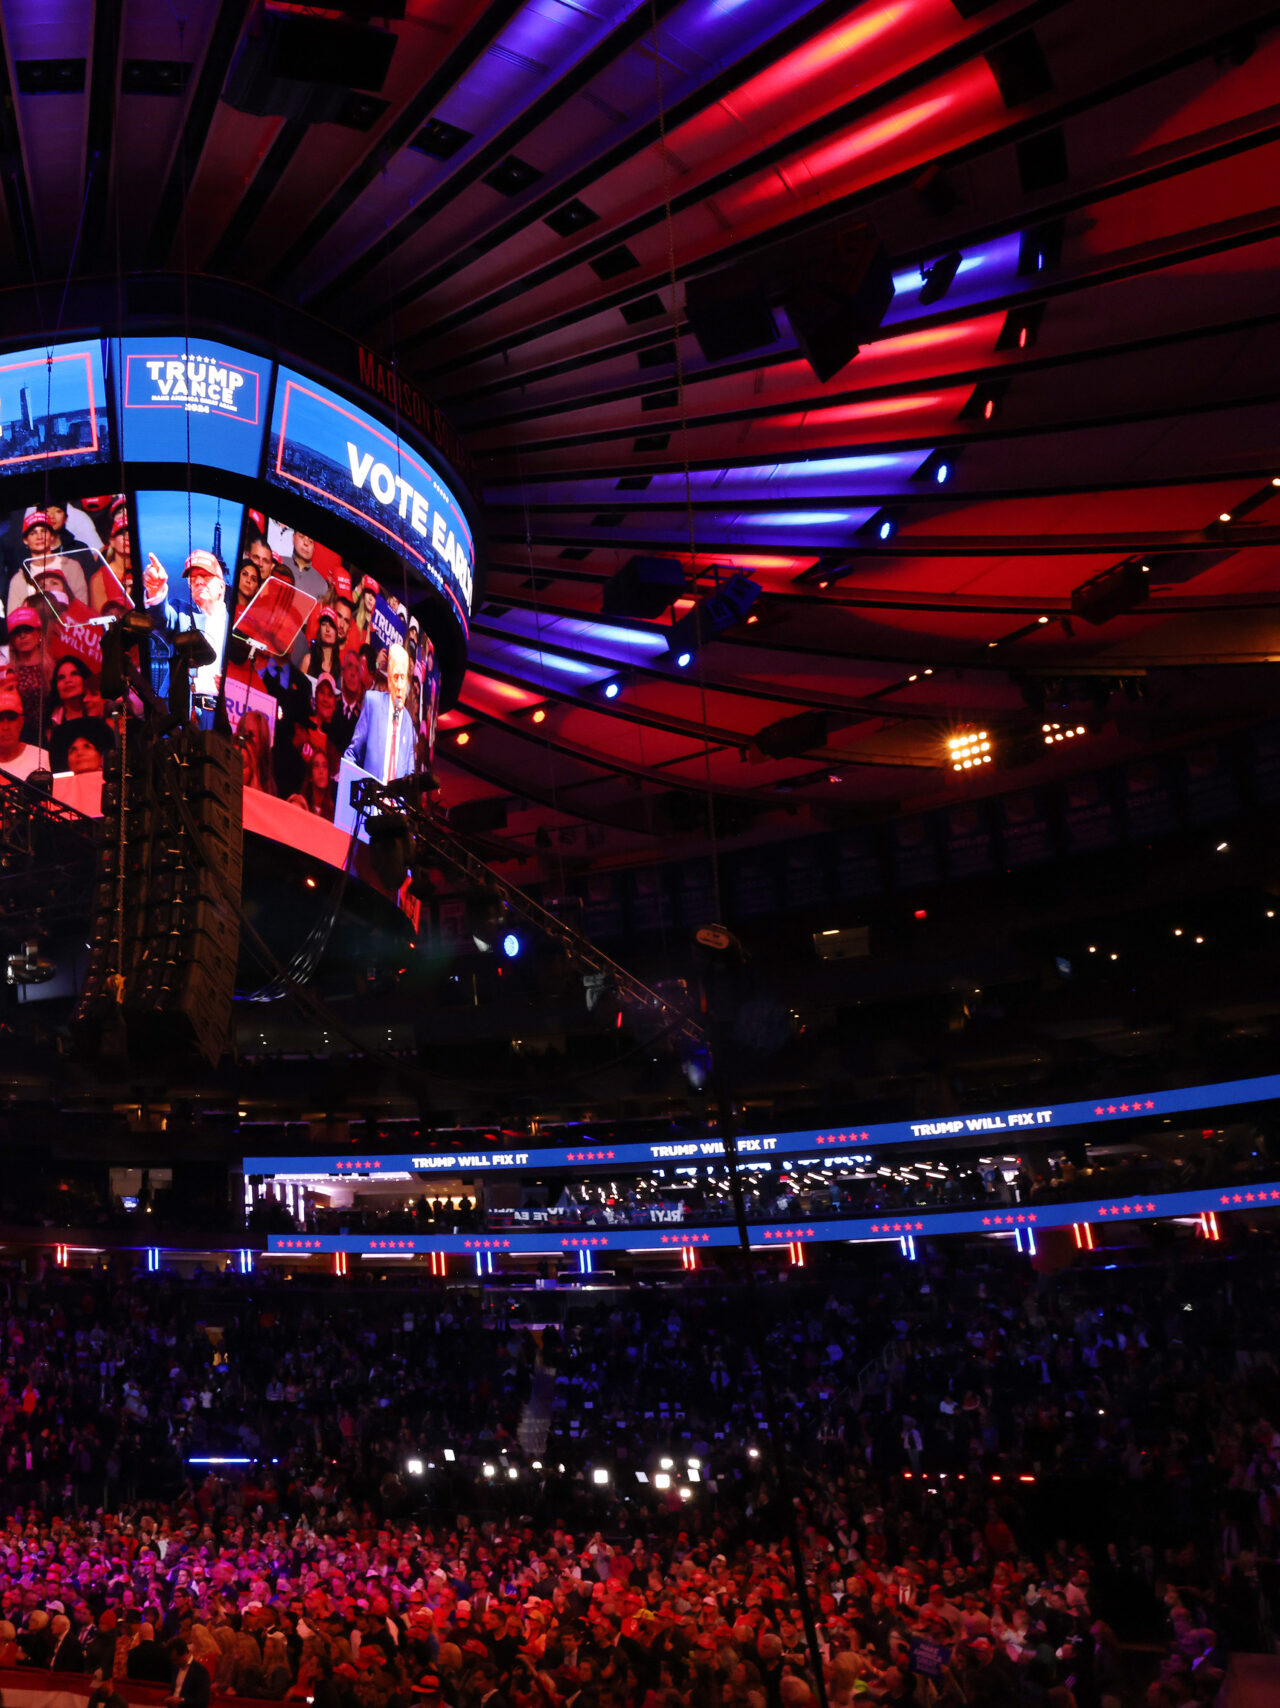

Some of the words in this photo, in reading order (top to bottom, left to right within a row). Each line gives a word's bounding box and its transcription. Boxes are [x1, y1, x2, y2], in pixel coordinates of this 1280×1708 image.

[146, 361, 244, 390] TRUMP
[158, 380, 234, 404] VANCE
[359, 346, 431, 433] MADISON
[347, 441, 429, 537] VOTE
[911, 1121, 964, 1136] TRUMP
[966, 1117, 1006, 1131] WILL
[1008, 1113, 1035, 1126] FIX
[1037, 1111, 1052, 1123] IT
[650, 1144, 698, 1157] TRUMP
[700, 1142, 736, 1154] WIL
[737, 1139, 761, 1151] FIX
[763, 1138, 777, 1149] IT
[412, 1157, 456, 1168] TRUMP
[458, 1155, 491, 1166] WILL
[492, 1154, 514, 1165] FIX
[516, 1154, 528, 1164] IT
